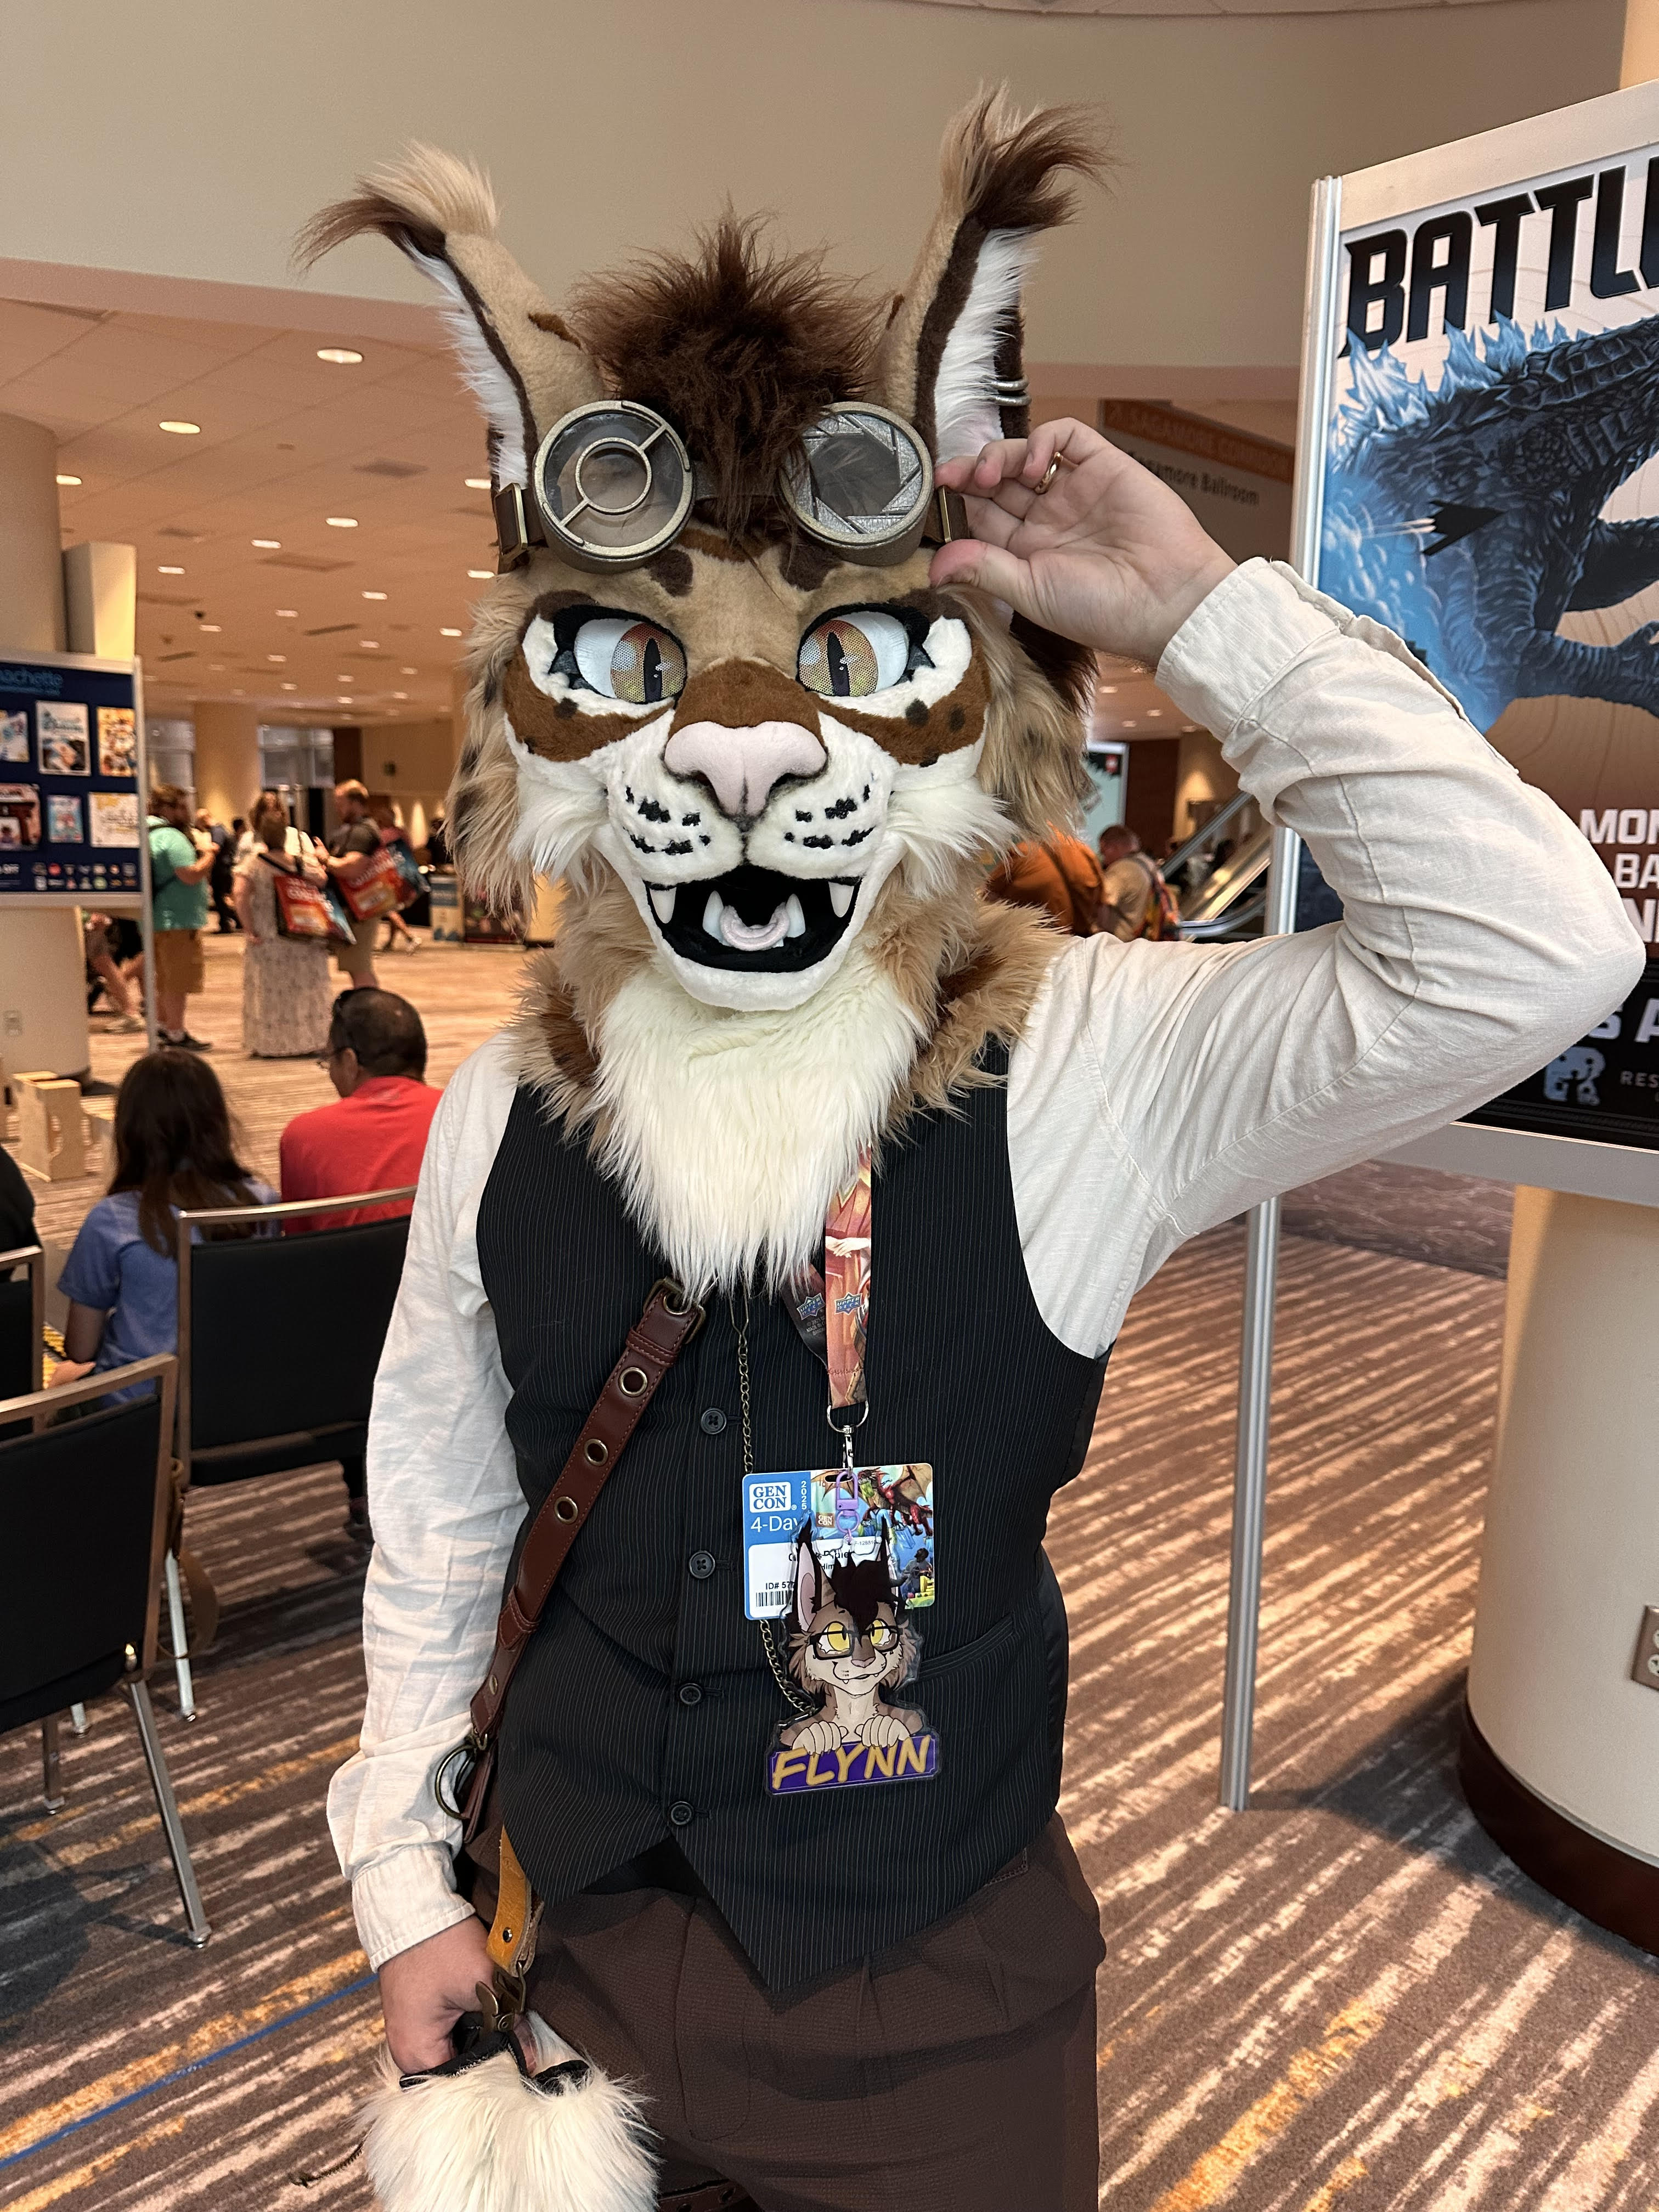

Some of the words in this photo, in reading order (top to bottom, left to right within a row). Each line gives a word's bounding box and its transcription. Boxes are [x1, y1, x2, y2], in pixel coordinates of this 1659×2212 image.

[1337, 156, 1659, 358] BATTL
[837, 1296, 860, 1306] UPPER
[837, 1301, 859, 1311] DECK
[753, 1485, 787, 1498] GEN
[753, 1497, 787, 1510] CON
[765, 1582, 780, 1590] ID#
[772, 1734, 932, 1790] FLYNN
